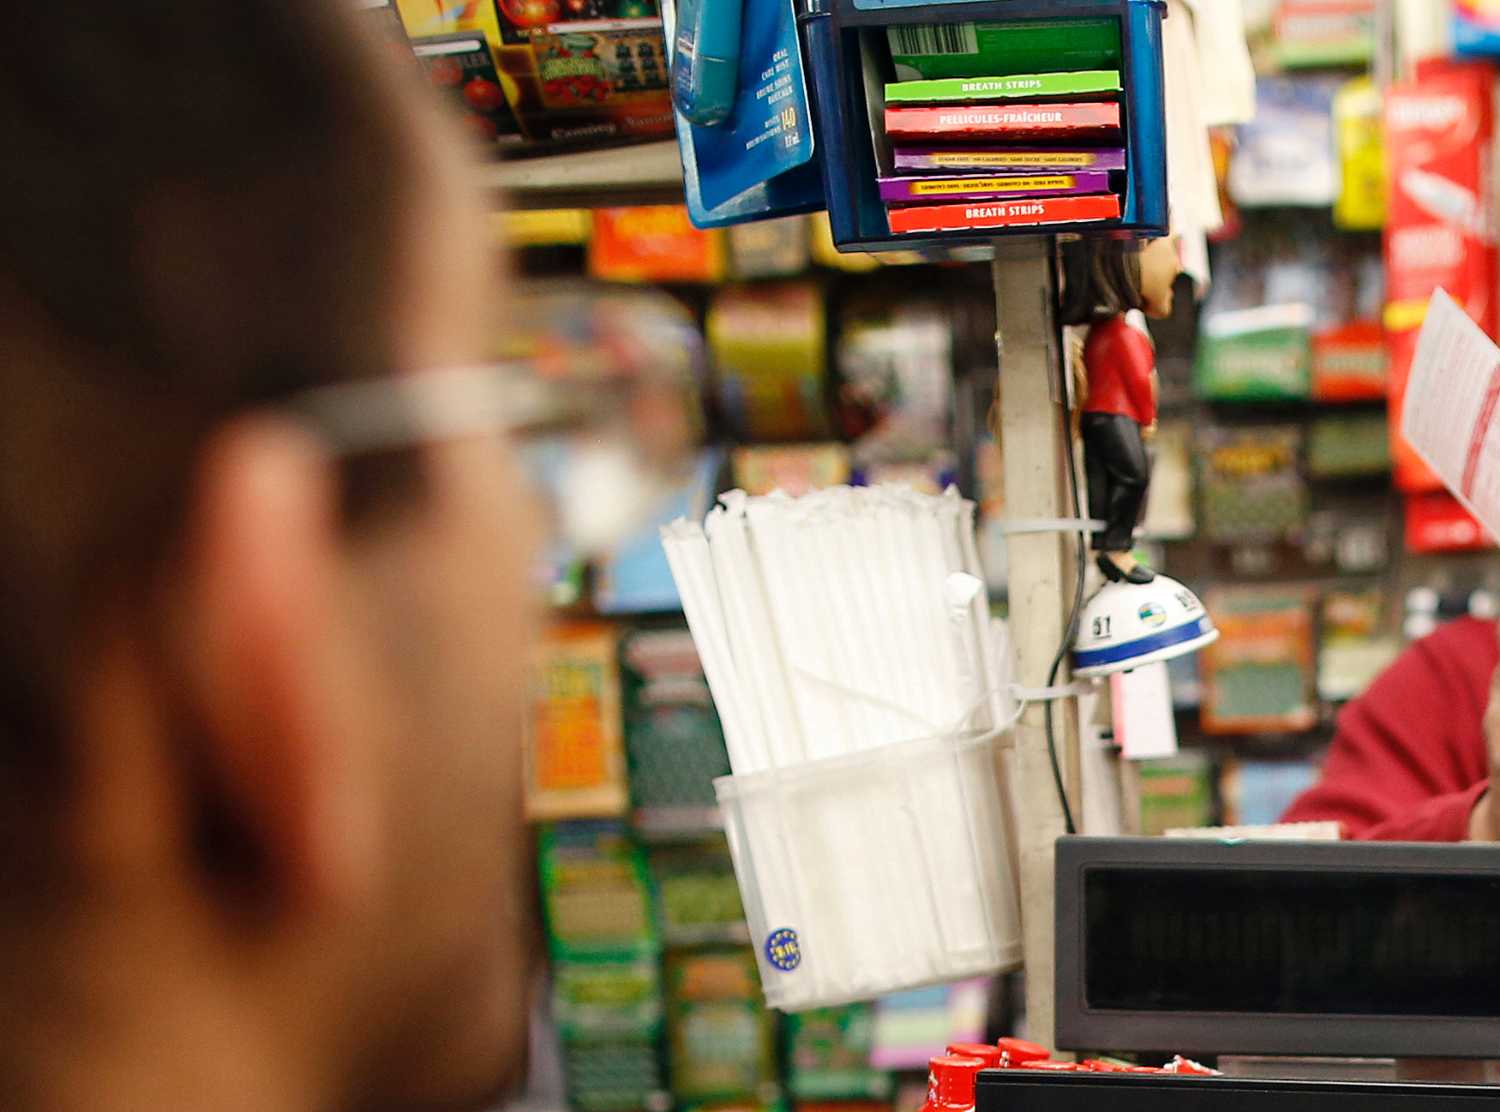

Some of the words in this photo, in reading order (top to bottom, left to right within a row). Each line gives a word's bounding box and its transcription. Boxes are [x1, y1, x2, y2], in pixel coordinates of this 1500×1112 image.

[962, 82, 1002, 92] BREATH
[1005, 79, 1042, 90] STRIPS
[965, 207, 1006, 220] BREATH
[1008, 204, 1045, 217] STRIPS
